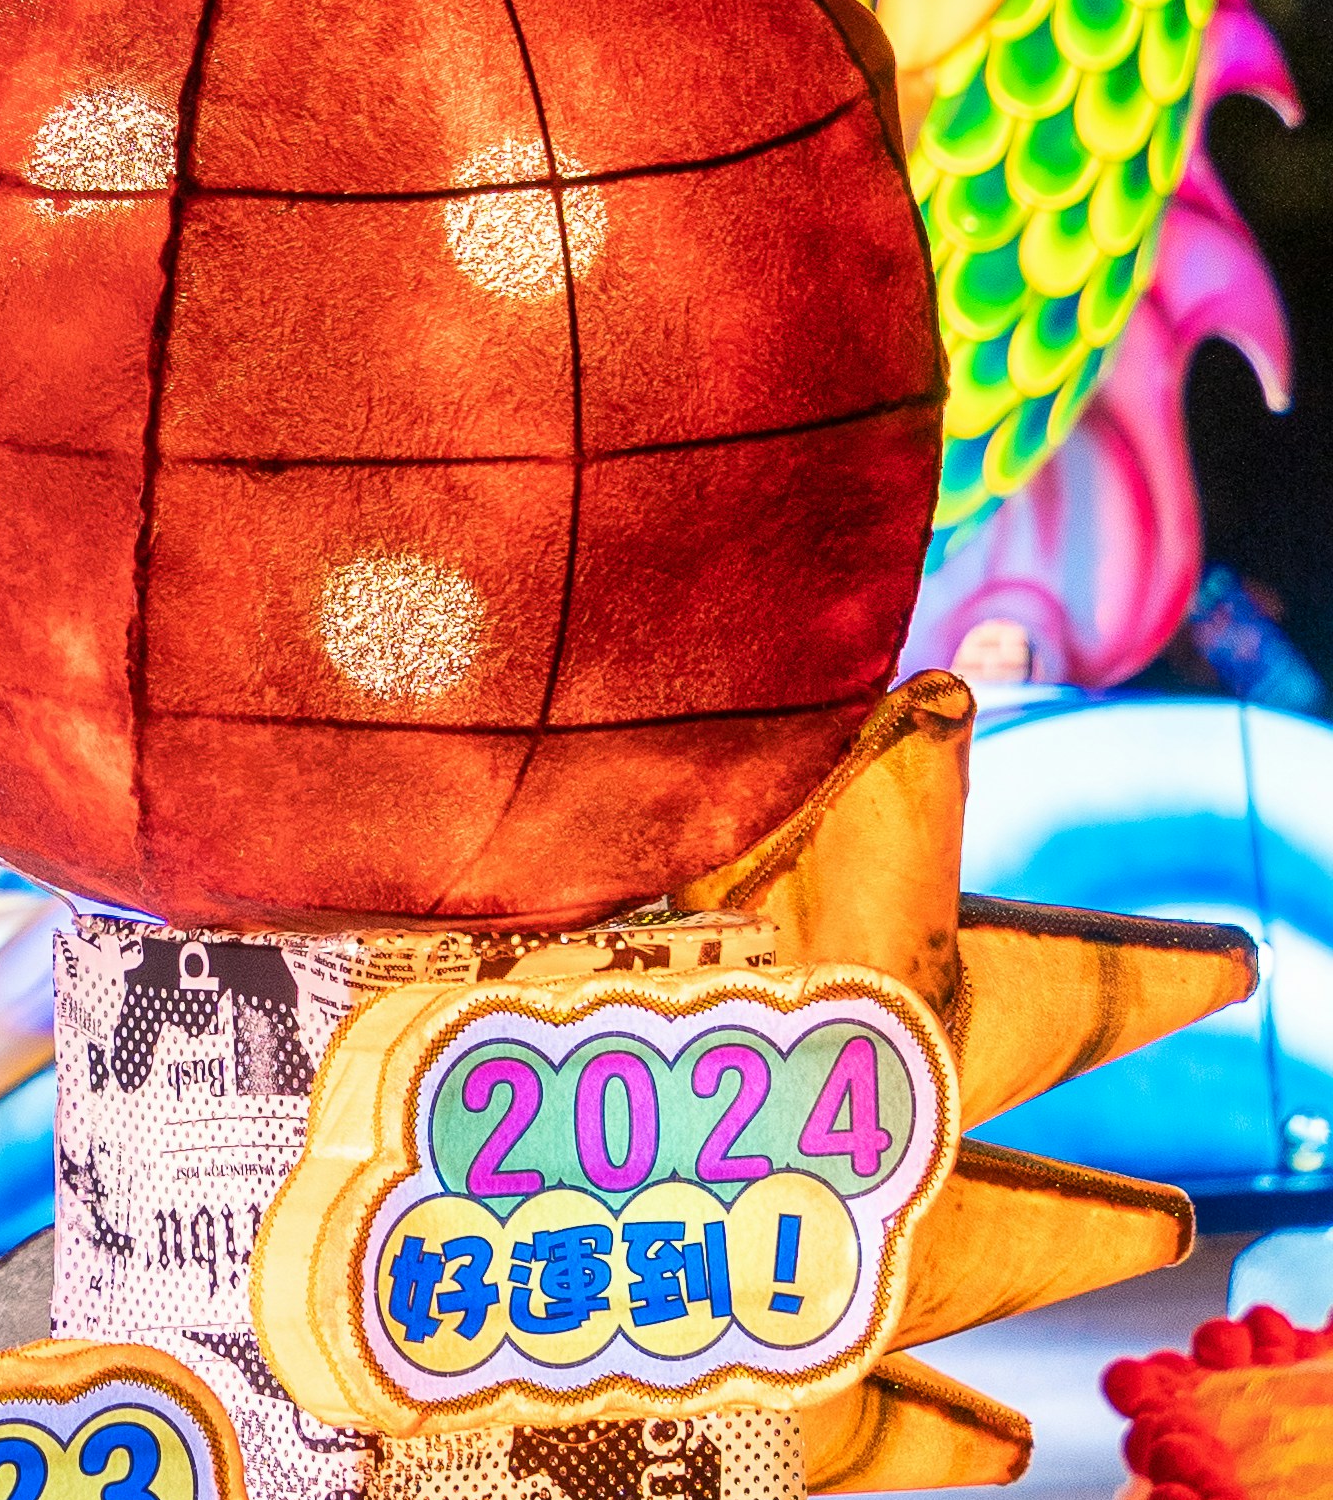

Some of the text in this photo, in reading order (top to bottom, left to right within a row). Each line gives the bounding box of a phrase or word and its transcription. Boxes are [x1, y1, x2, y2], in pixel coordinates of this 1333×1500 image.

[167, 1056, 226, 1097] Bush
[461, 1036, 892, 1197] 2024
[386, 1211, 803, 1345] 好運到！
